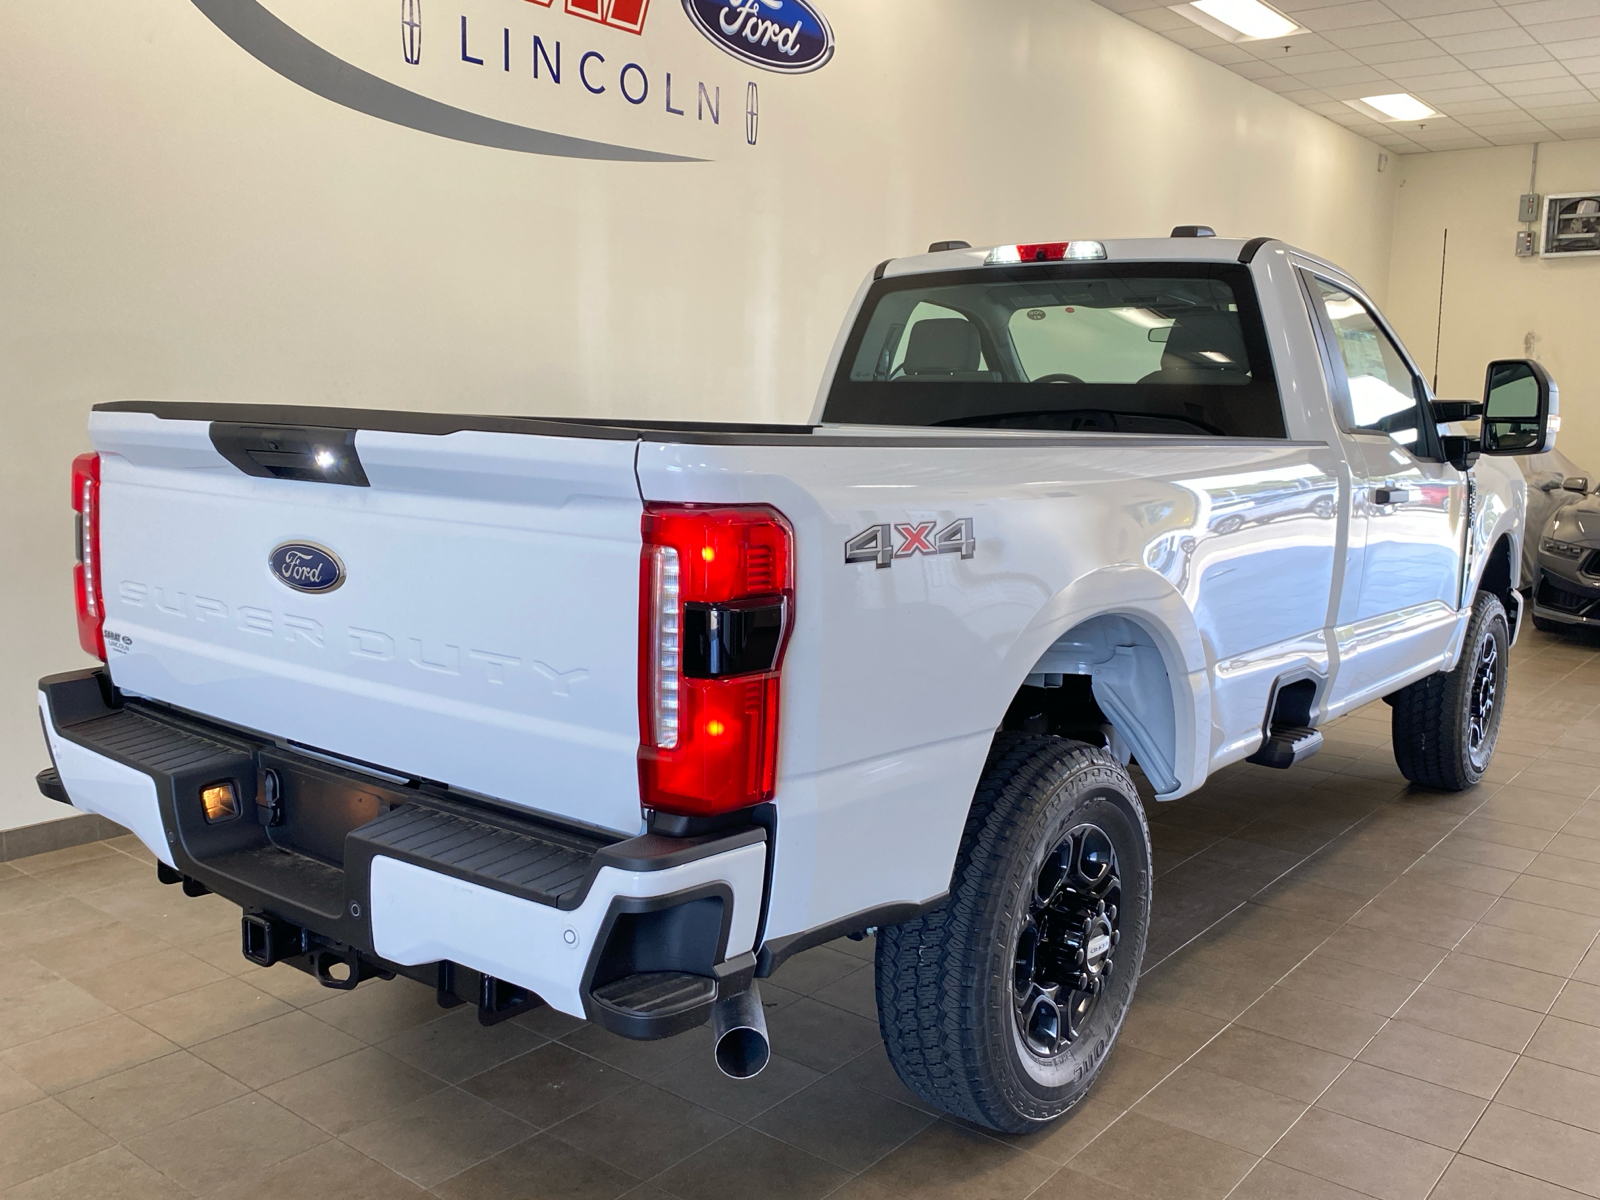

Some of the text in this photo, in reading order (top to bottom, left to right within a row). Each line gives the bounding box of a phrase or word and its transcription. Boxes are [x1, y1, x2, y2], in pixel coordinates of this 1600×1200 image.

[719, 0, 803, 56] Ford
[461, 15, 720, 125] LINCOLN
[281, 550, 324, 583] Ford
[119, 580, 590, 697] SUPER DUTY
